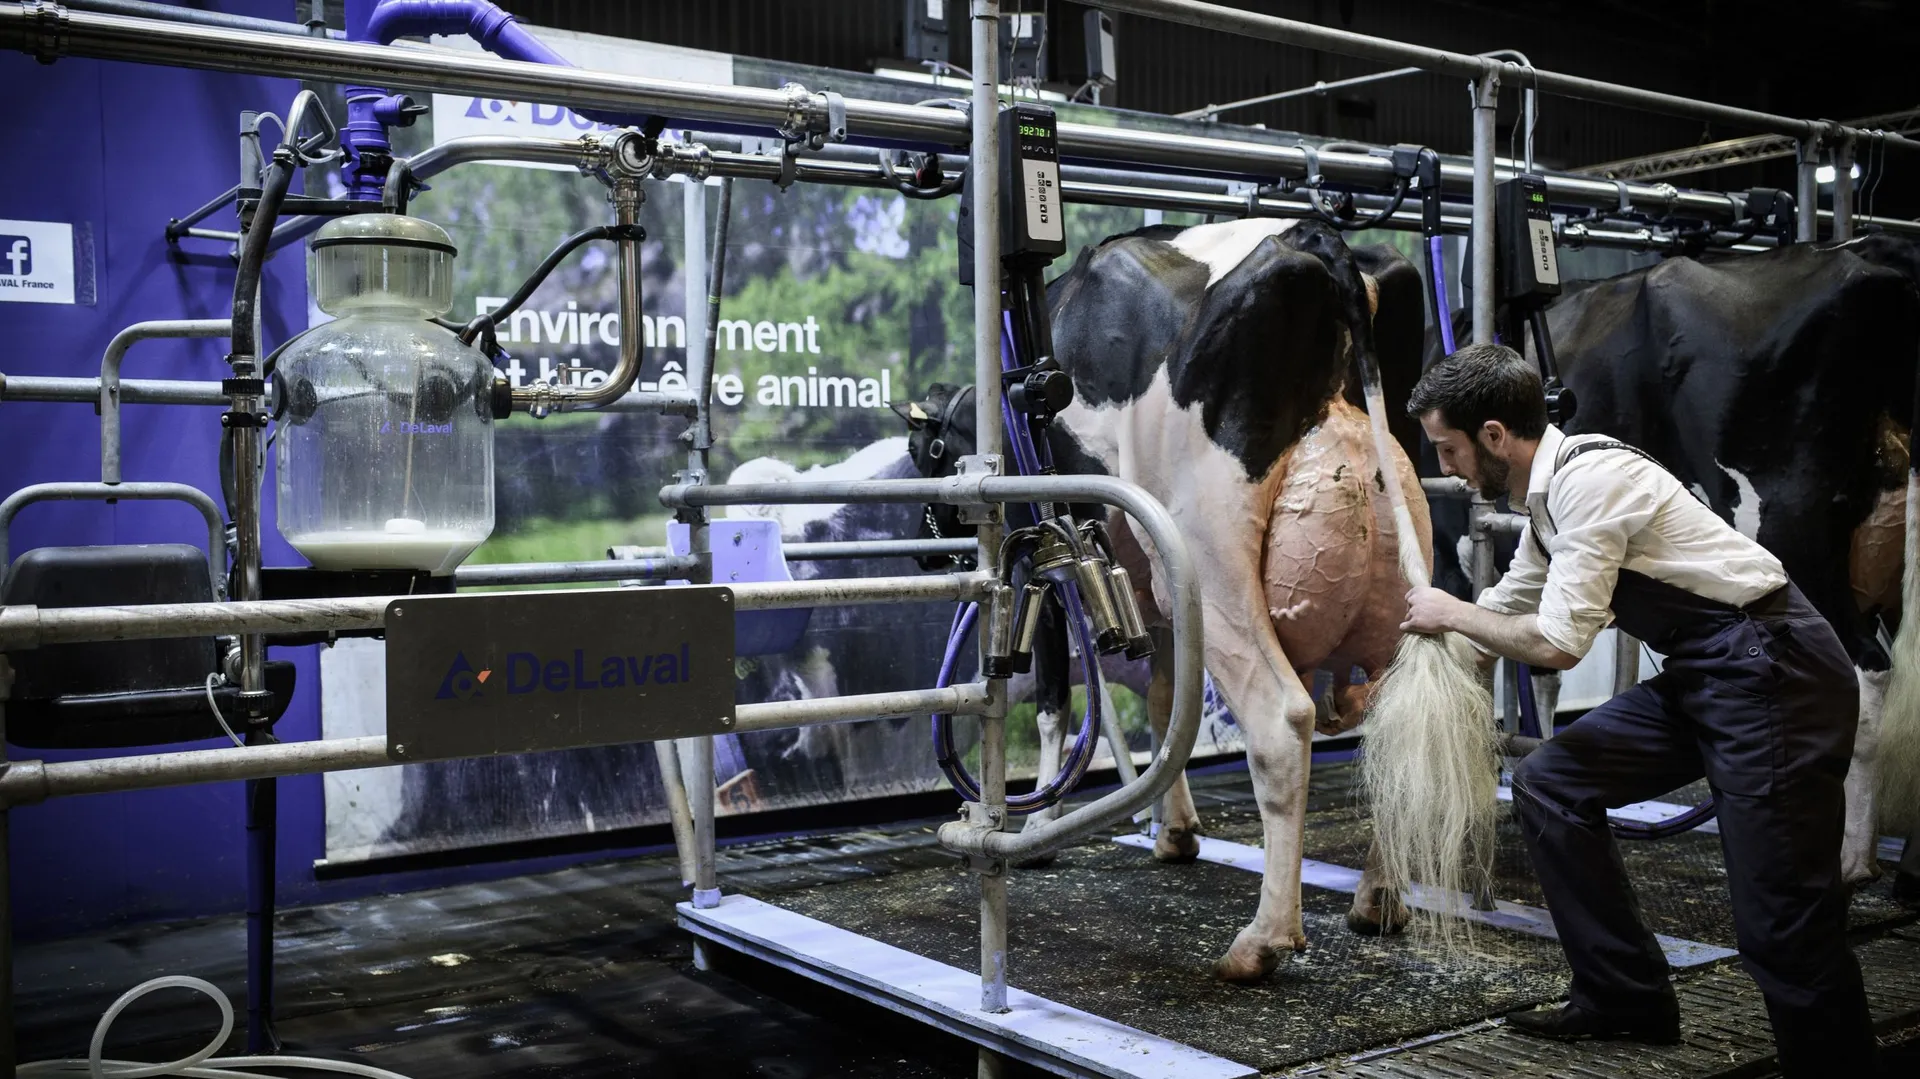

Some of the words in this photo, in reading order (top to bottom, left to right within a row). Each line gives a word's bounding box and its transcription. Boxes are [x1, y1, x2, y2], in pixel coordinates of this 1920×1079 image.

[0, 279, 19, 288] VAL
[22, 280, 54, 289] France
[757, 366, 891, 408] animal
[400, 421, 453, 433] DeLaval
[506, 642, 690, 695] DeLaval
